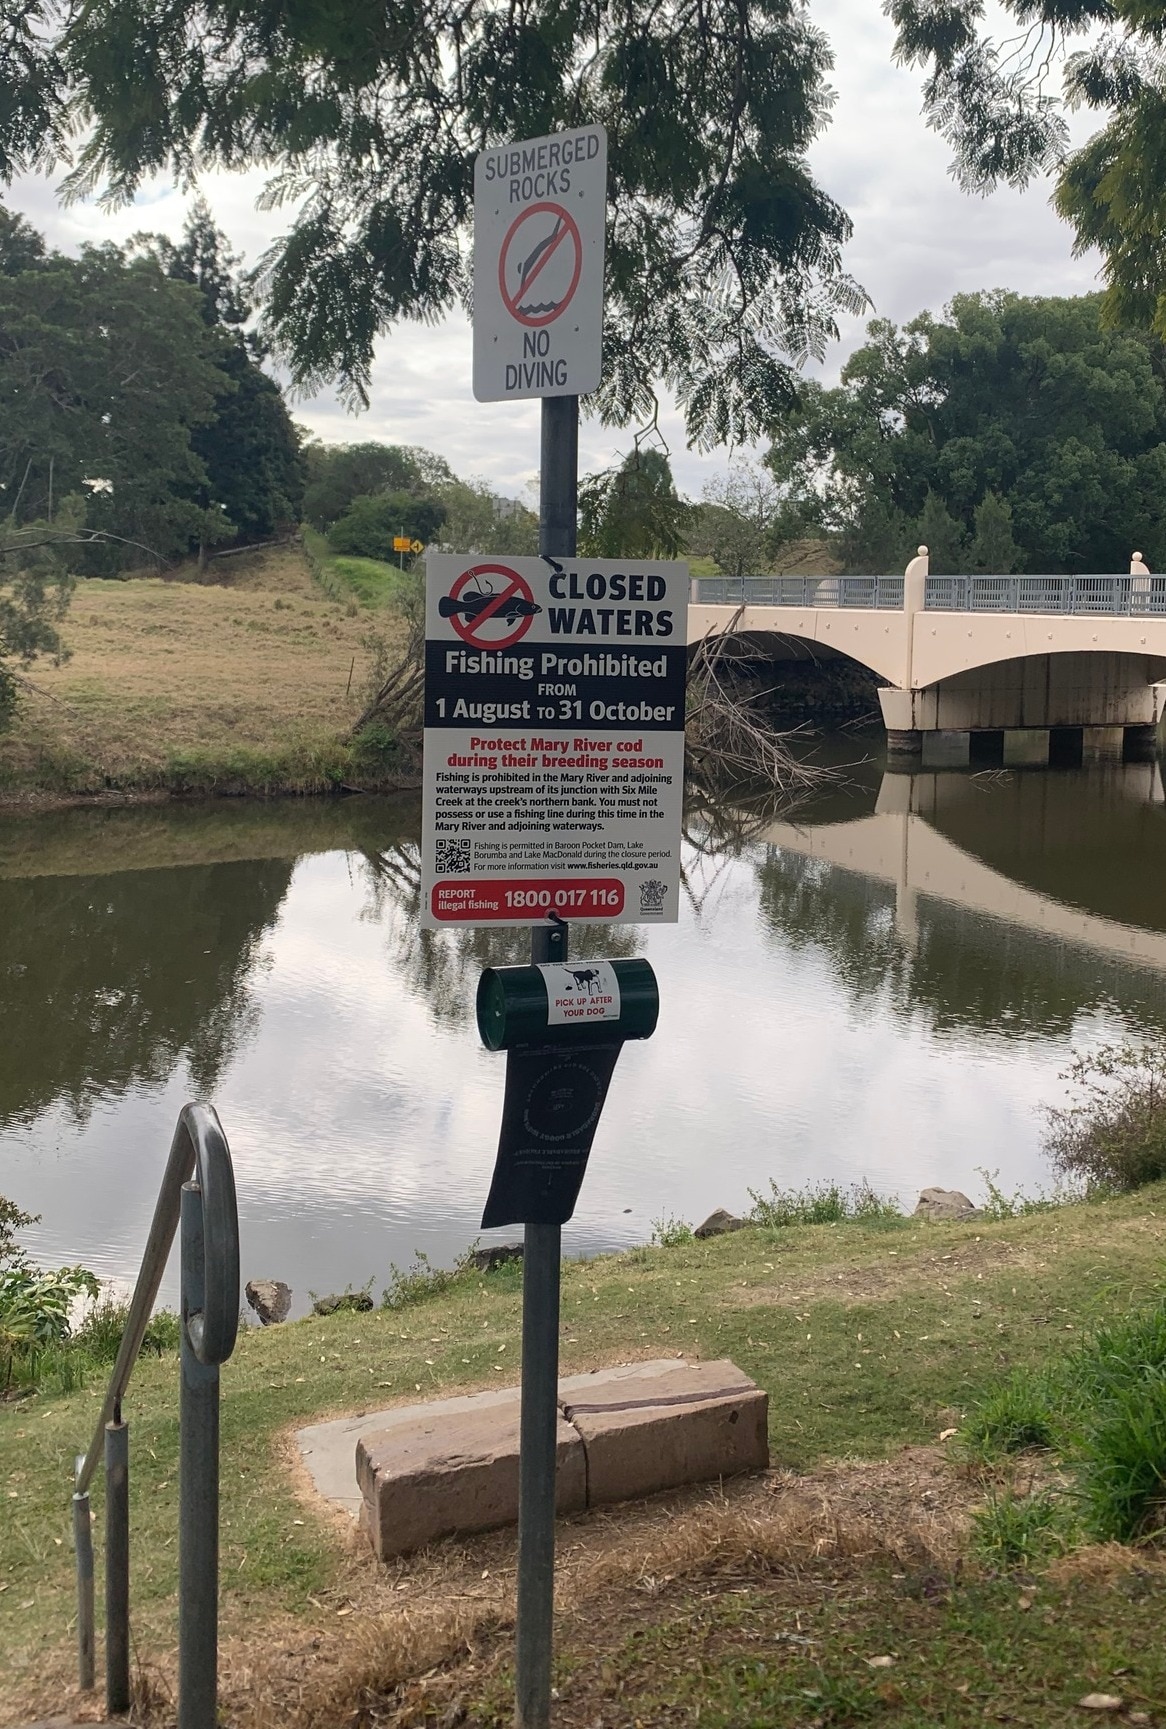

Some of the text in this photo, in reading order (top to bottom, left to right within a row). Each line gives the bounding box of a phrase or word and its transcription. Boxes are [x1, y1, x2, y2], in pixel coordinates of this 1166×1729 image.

[485, 134, 599, 181] SUBMERGED
[510, 168, 570, 203] ROCKS
[524, 330, 550, 358] NO
[506, 360, 567, 390] DIVING
[549, 573, 666, 601] CLOSED
[548, 608, 673, 636] WATERS
[446, 651, 667, 679] Fishing Prohibited
[538, 684, 577, 696] FROM
[436, 699, 675, 723] 1 August TO 31 October
[470, 737, 642, 754] Protect Mary River cod
[448, 753, 663, 770] during their breeding season
[436, 773, 672, 784] Fishing is prohibited in the Mary River and adjoining
[436, 785, 657, 796] waterways upstream of its junction with Six Mile
[436, 798, 463, 806] Creek
[477, 798, 492, 806] the
[495, 798, 527, 806] creek’s
[530, 798, 570, 806] northern
[572, 798, 596, 806] bank.
[599, 798, 615, 806] You
[618, 799, 640, 807] must
[643, 799, 657, 807] not
[436, 811, 473, 820] possess
[514, 809, 545, 820] fishing
[547, 810, 564, 818] line
[566, 810, 596, 820] during
[598, 810, 614, 818] this
[617, 810, 636, 818] time
[639, 810, 647, 818] in
[650, 810, 664, 818] the
[435, 822, 604, 833] Mary River and adjoining waterways.
[474, 842, 499, 851] Fishing
[510, 842, 544, 851] permitted
[582, 841, 605, 849] Pocket
[608, 841, 625, 850] Dam,
[543, 850, 582, 858] MacDonald
[584, 850, 606, 859] during
[608, 850, 619, 858] the
[621, 850, 646, 858] closure
[648, 850, 672, 859] period.
[508, 862, 549, 870] information
[568, 862, 658, 871] www.fisheries.qld.gov.au
[439, 890, 476, 898] REPORT
[505, 889, 619, 907] 1800 017 116
[439, 900, 466, 910] illegal
[468, 900, 498, 910] fishing
[590, 996, 612, 1004] AFTER
[564, 1009, 584, 1017] YOUR
